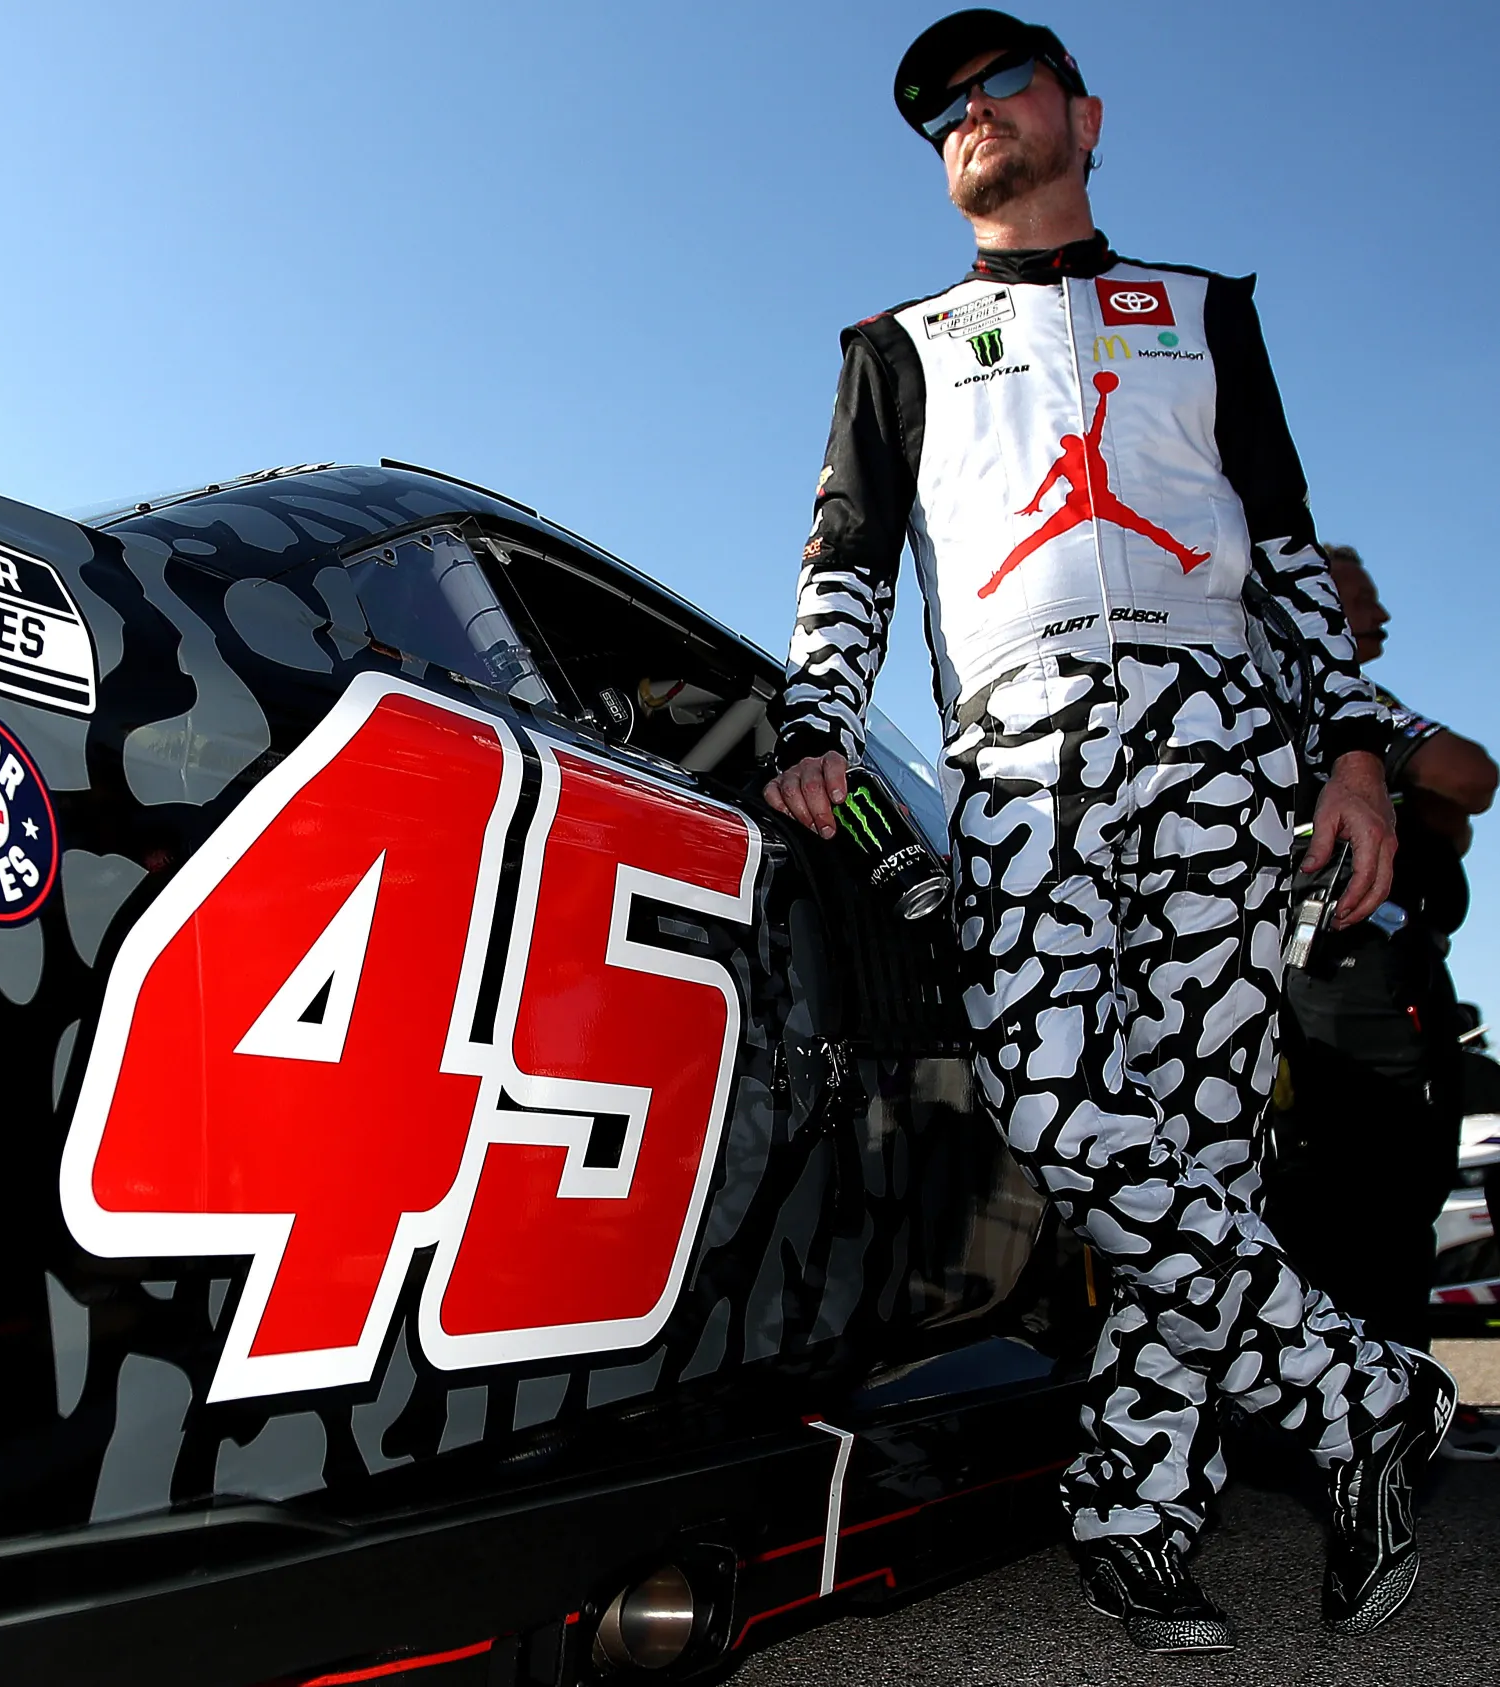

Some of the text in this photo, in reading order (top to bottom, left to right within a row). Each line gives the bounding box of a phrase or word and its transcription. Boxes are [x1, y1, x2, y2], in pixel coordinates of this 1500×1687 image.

[1138, 349, 1204, 360] MoneyLion
[954, 364, 1030, 388] GOODYEAR
[1041, 607, 1170, 639] KURT BUSCH
[60, 671, 761, 1404] 45
[1433, 1387, 1452, 1434] 45
